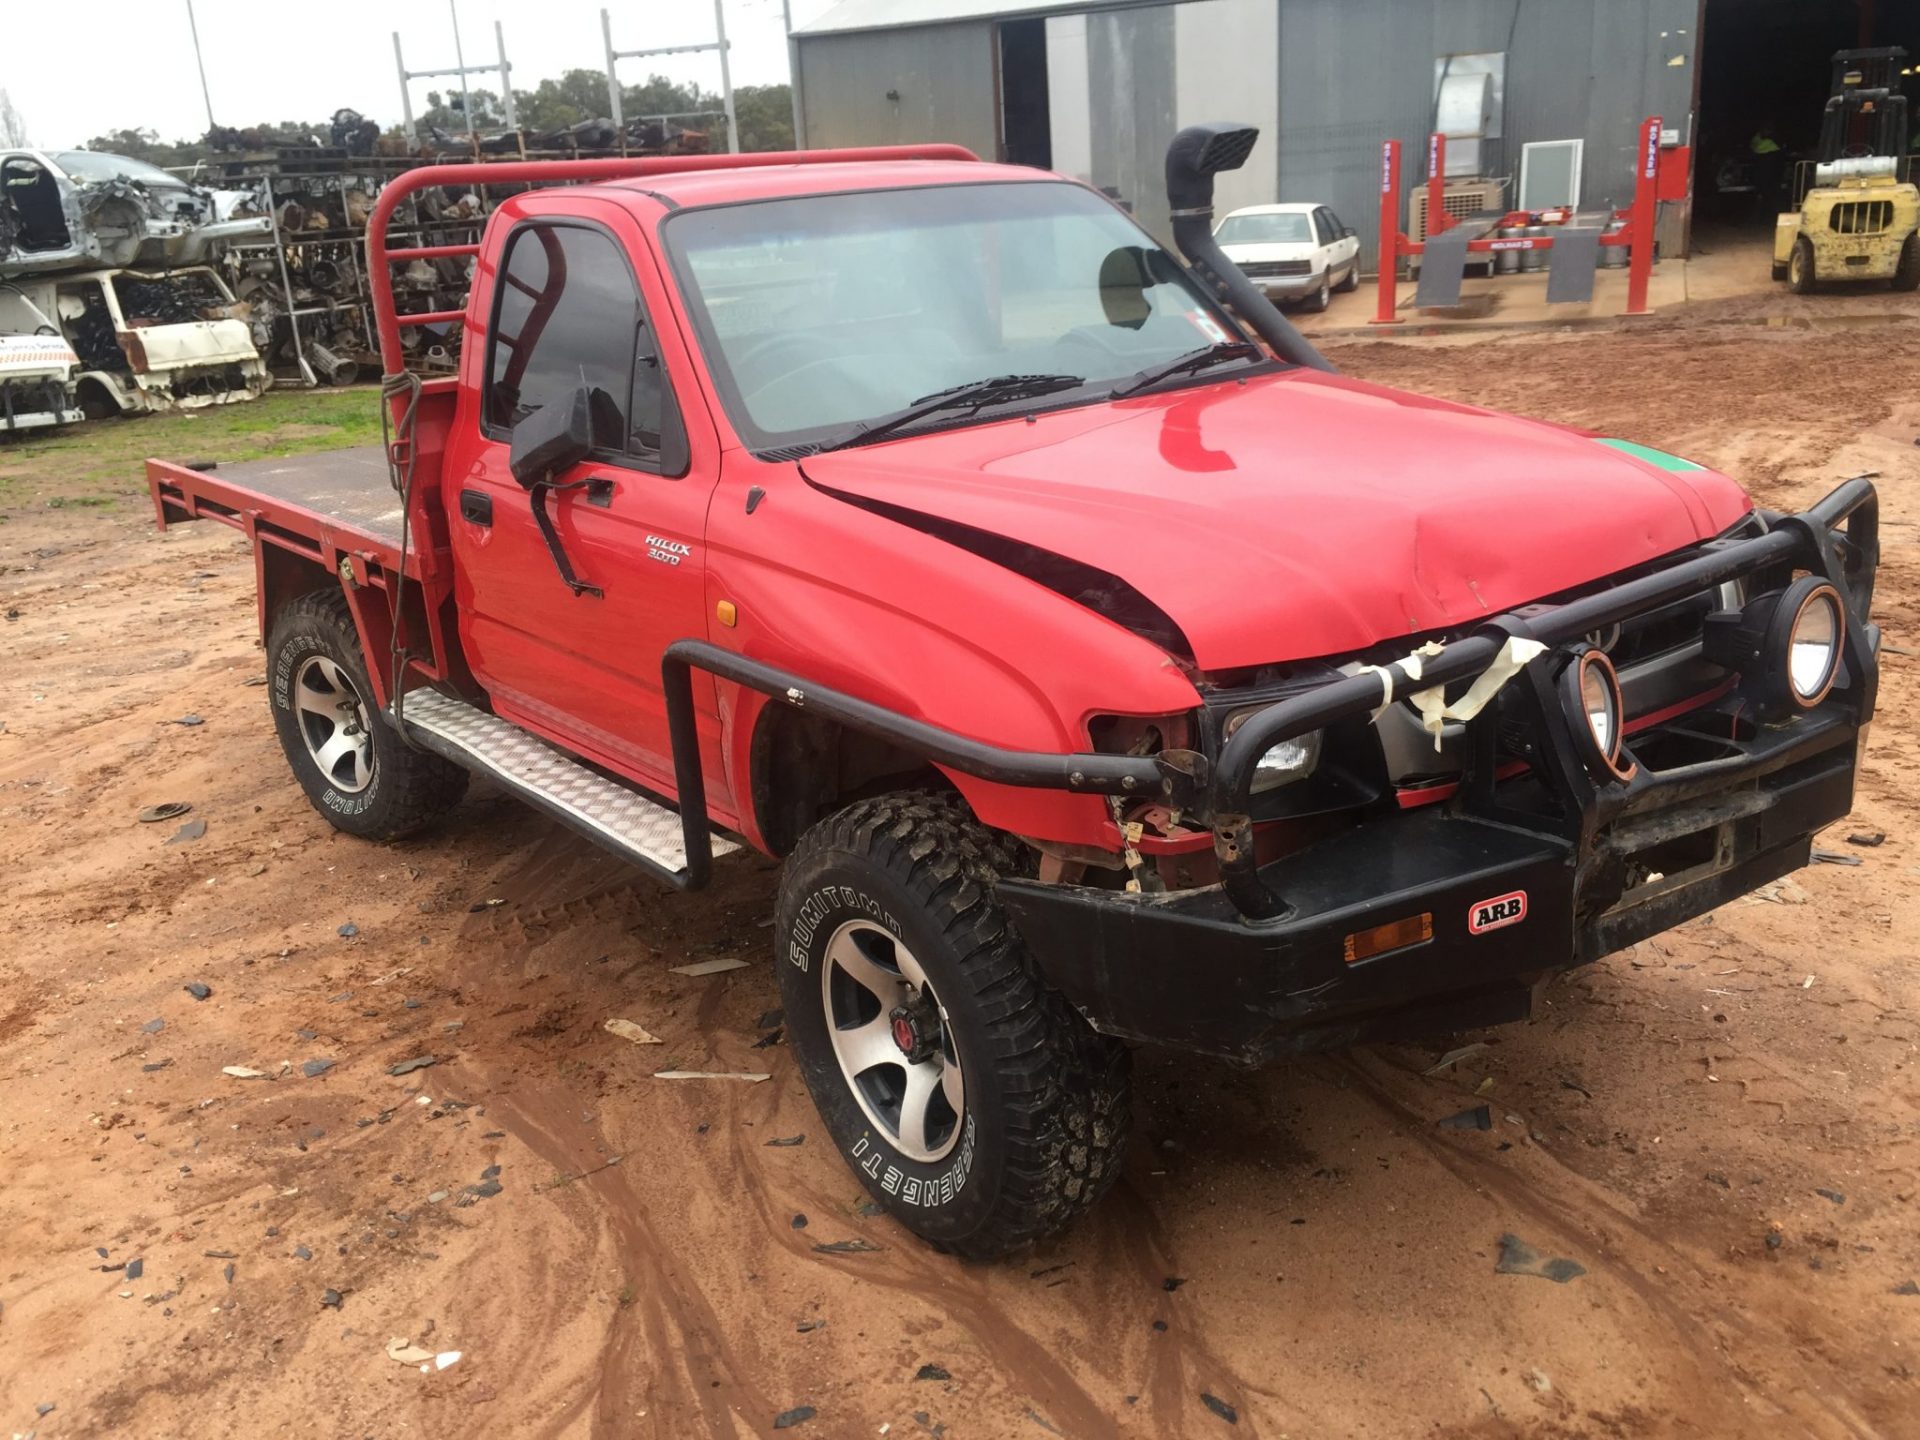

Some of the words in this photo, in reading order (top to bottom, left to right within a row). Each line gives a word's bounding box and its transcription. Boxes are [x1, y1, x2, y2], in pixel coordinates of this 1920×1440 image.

[645, 535, 691, 556] HILUX
[790, 886, 902, 973] SUMITOMO
[1476, 898, 1521, 927] ARB
[852, 1107, 976, 1207] SERENGETI
